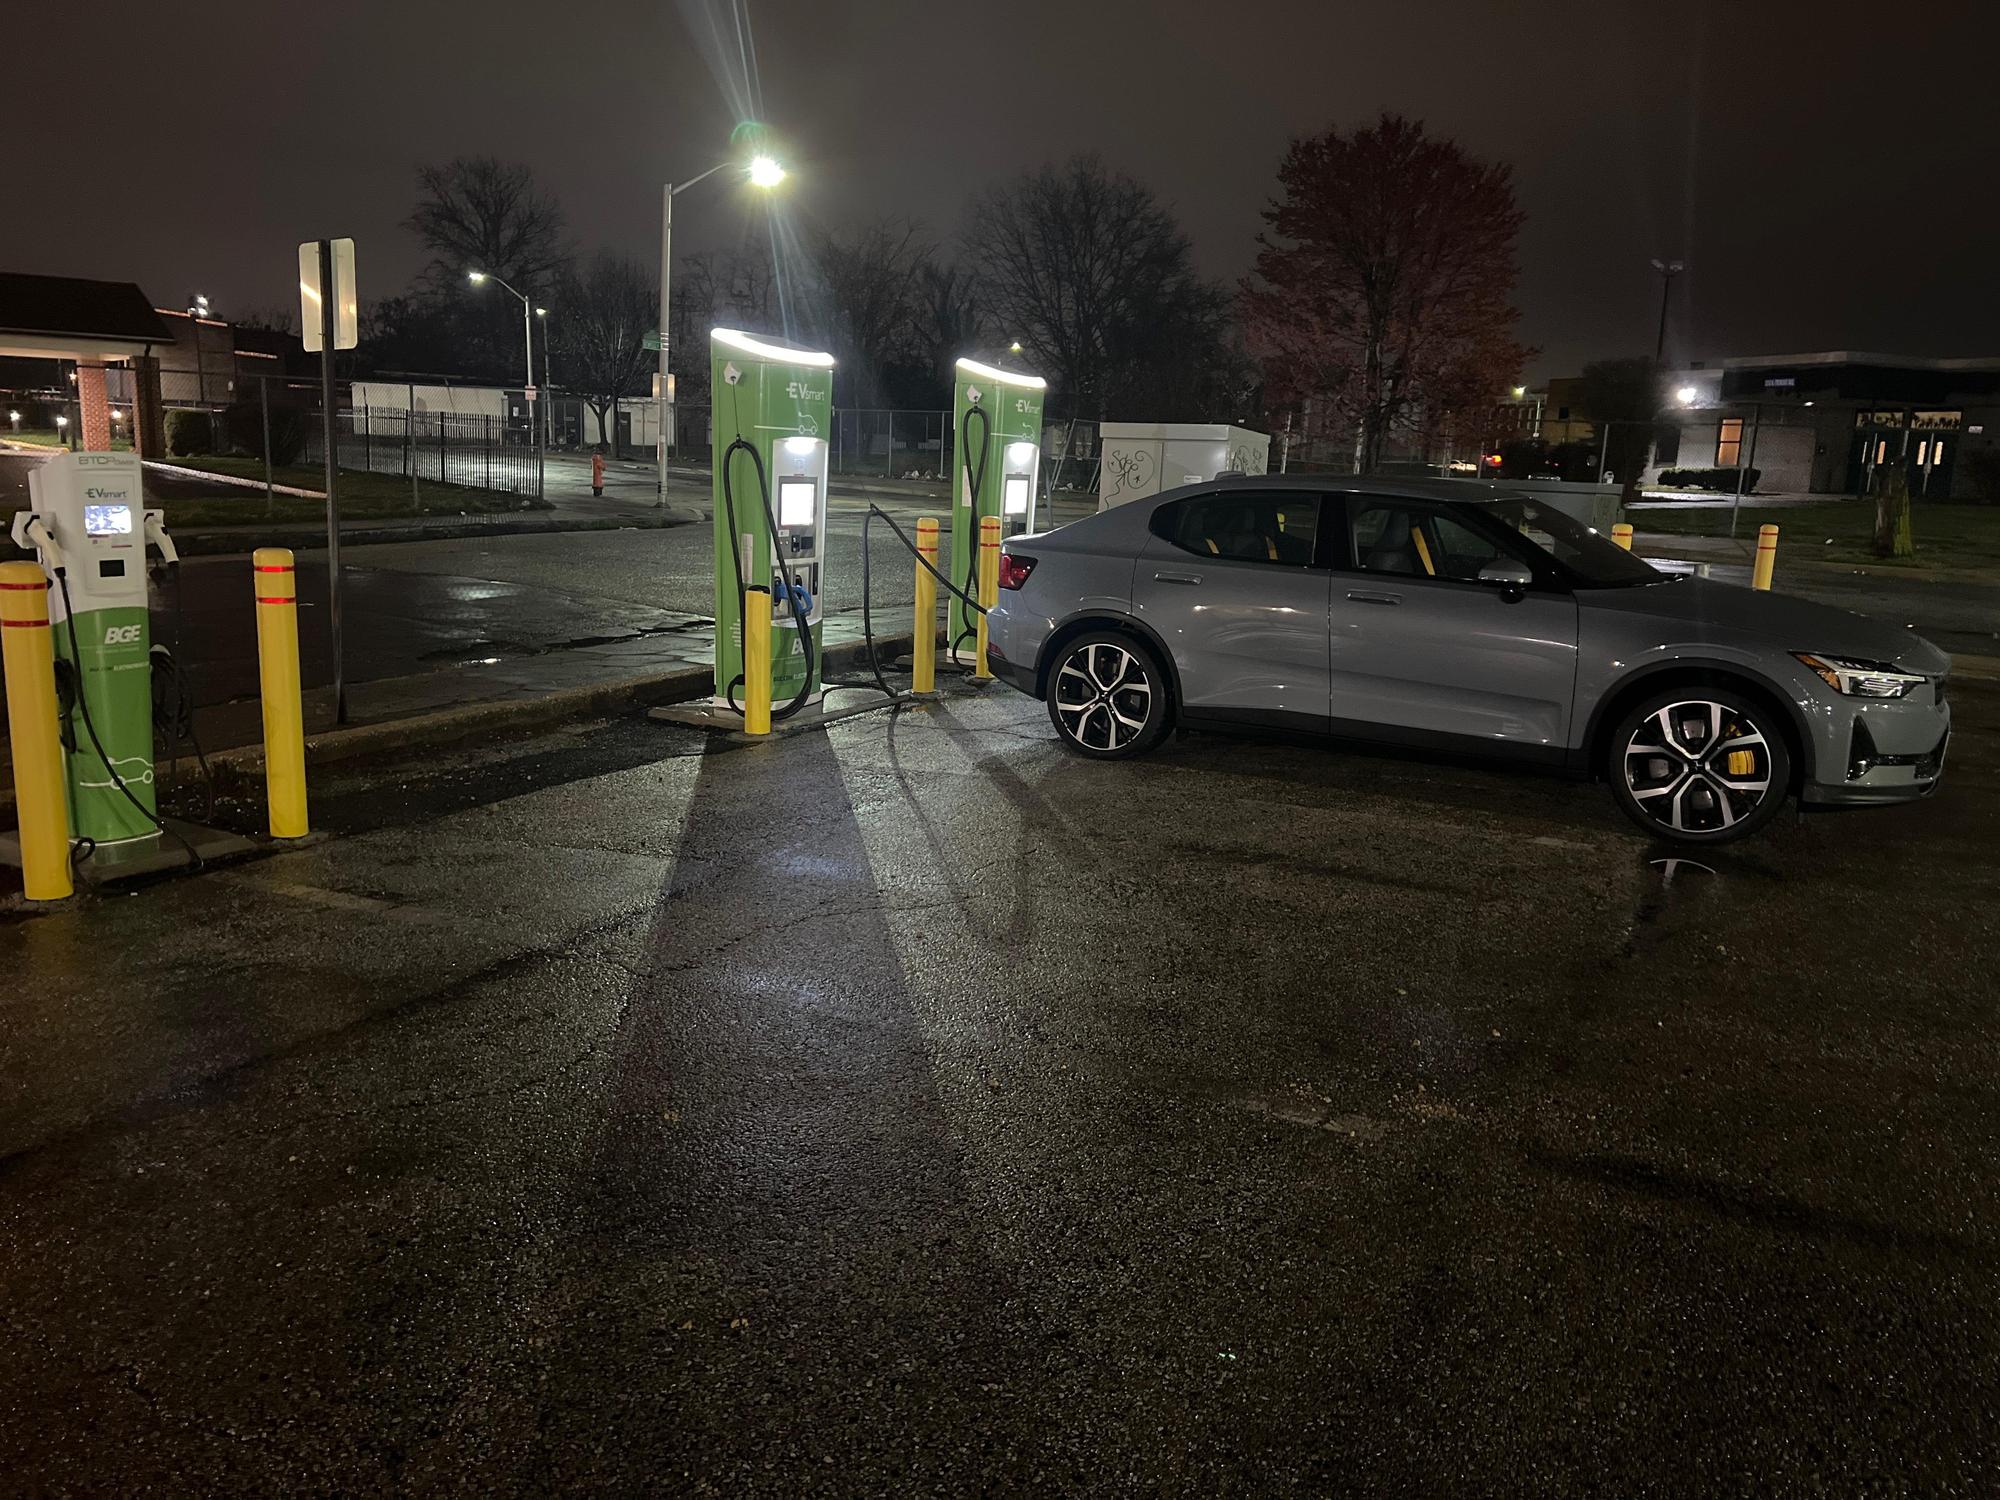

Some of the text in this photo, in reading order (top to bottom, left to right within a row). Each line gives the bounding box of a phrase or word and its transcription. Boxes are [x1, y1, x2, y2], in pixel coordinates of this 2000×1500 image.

[786, 381, 825, 400] EVsmart
[85, 488, 127, 498] EVsmart
[104, 624, 141, 644] BGE
